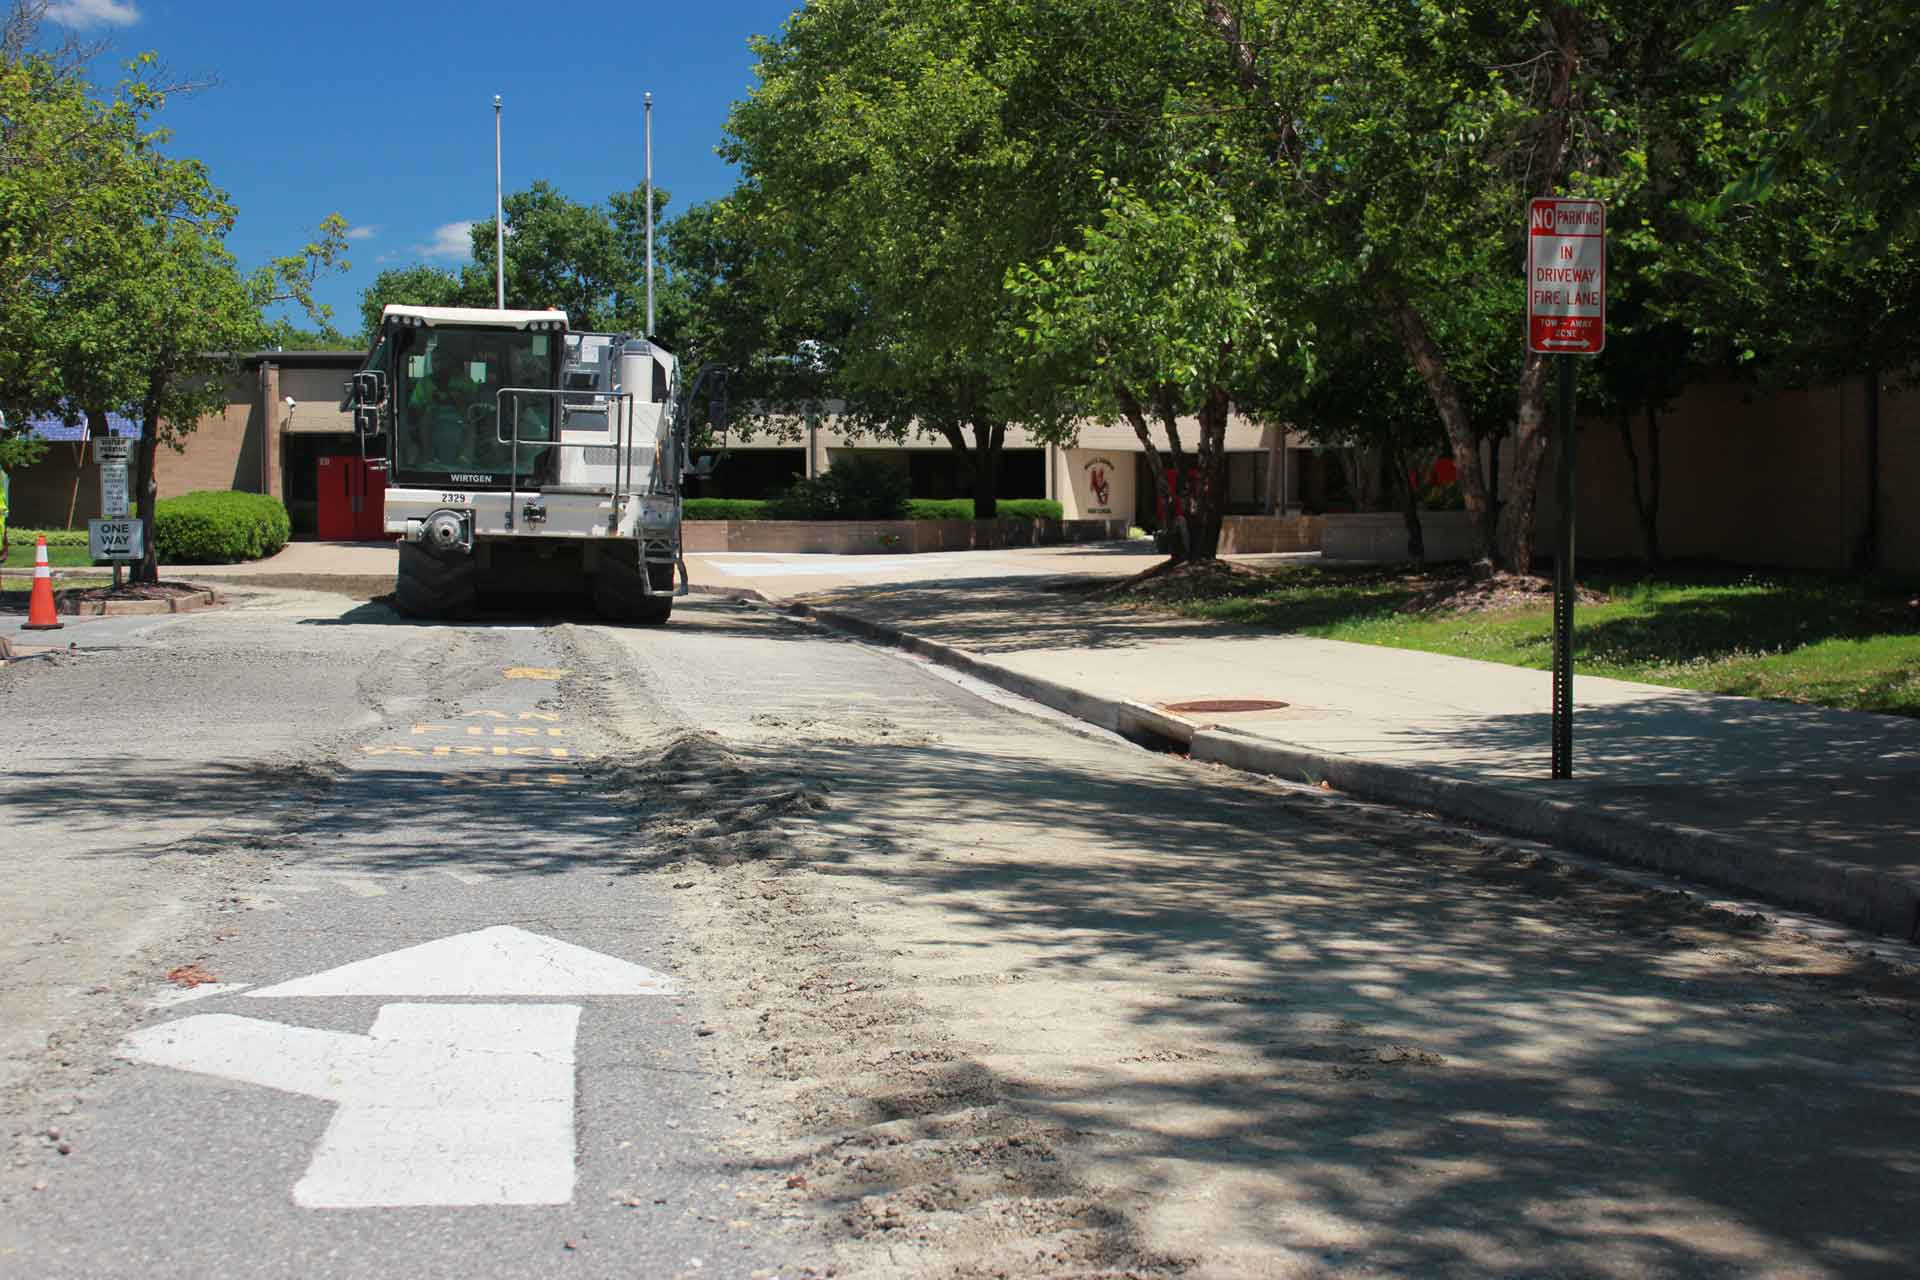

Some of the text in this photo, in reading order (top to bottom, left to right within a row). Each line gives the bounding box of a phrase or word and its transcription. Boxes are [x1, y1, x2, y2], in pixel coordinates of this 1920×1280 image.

[1531, 208, 1600, 229] NO PARKING
[1560, 245, 1573, 259] IN
[1534, 290, 1600, 306] FIRE LANE
[1555, 329, 1577, 337] ZONE
[450, 473, 493, 483] WIRTGEN
[441, 493, 466, 503] 2329
[101, 523, 129, 534] ONE
[101, 535, 129, 545] WAY
